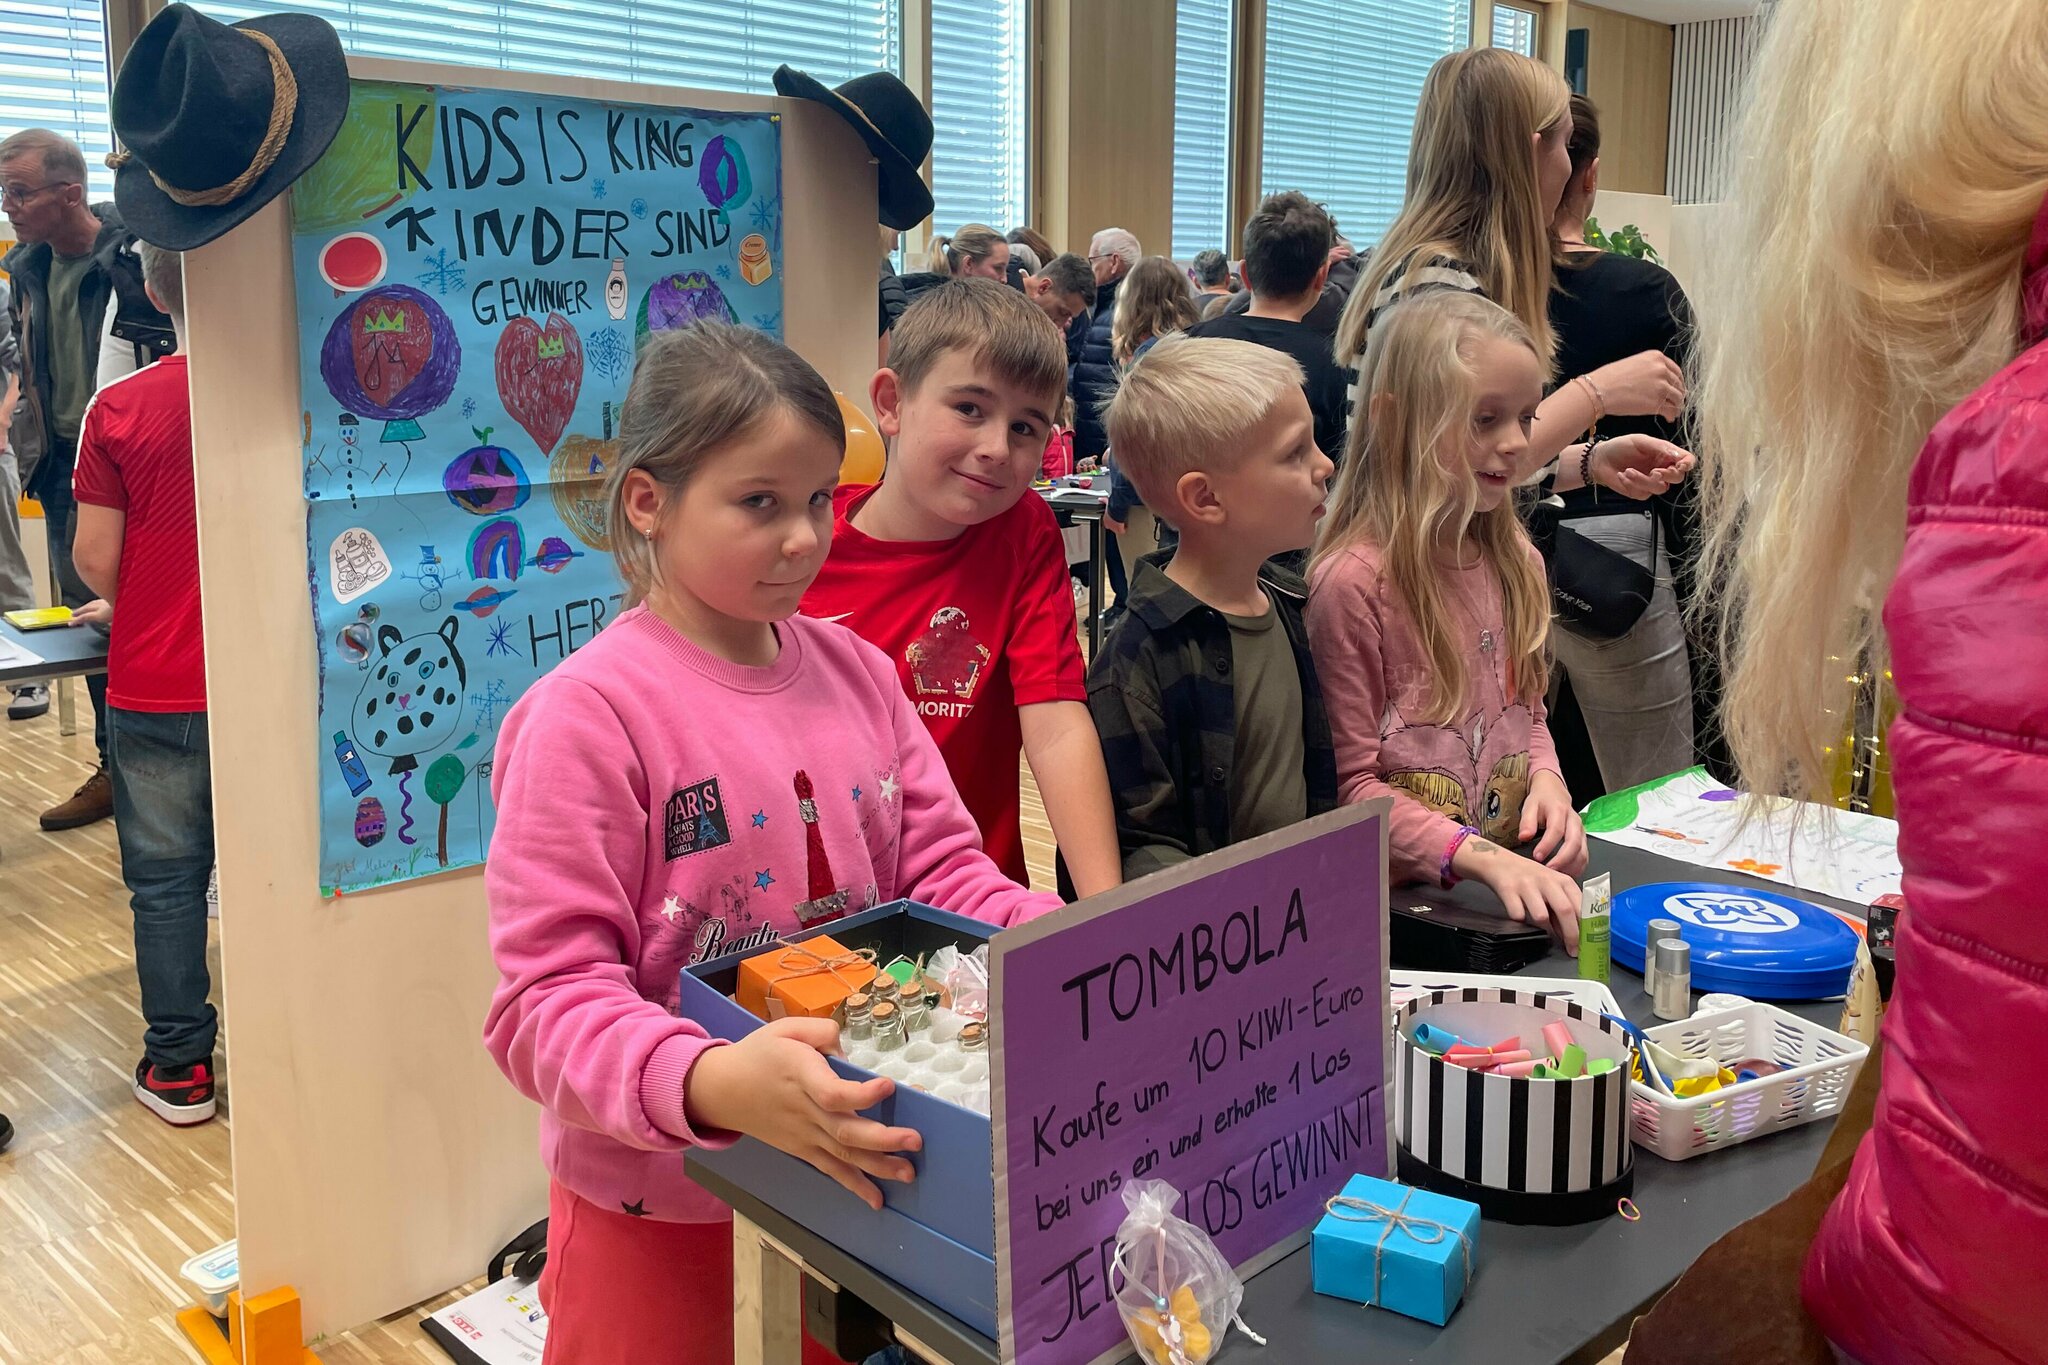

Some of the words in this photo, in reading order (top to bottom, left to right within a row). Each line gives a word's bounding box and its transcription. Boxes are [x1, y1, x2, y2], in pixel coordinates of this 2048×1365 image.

[396, 103, 525, 192] KIDS
[535, 107, 588, 184] IS
[607, 109, 696, 175] KING
[385, 206, 630, 266] KINDER
[650, 208, 731, 258] SIND
[472, 277, 592, 325] GEWINNER
[673, 831, 695, 845] GOOD
[1062, 888, 1308, 1042] TOMBOLA
[1033, 1080, 1122, 1168] Kaufe
[1134, 1081, 1169, 1114] um
[1188, 1036, 1227, 1085] 10
[1238, 977, 1364, 1062] KIWI-Euro
[1036, 1184, 1071, 1232] bei
[1081, 1170, 1122, 1206] uns
[1132, 1138, 1160, 1178] ein
[1169, 1114, 1203, 1159] und
[1214, 1081, 1278, 1135] erhalte
[1288, 1060, 1300, 1095] 1
[1311, 1047, 1351, 1085] Los
[1183, 1165, 1243, 1237] LOS
[1252, 1085, 1378, 1210] GEWINNT
